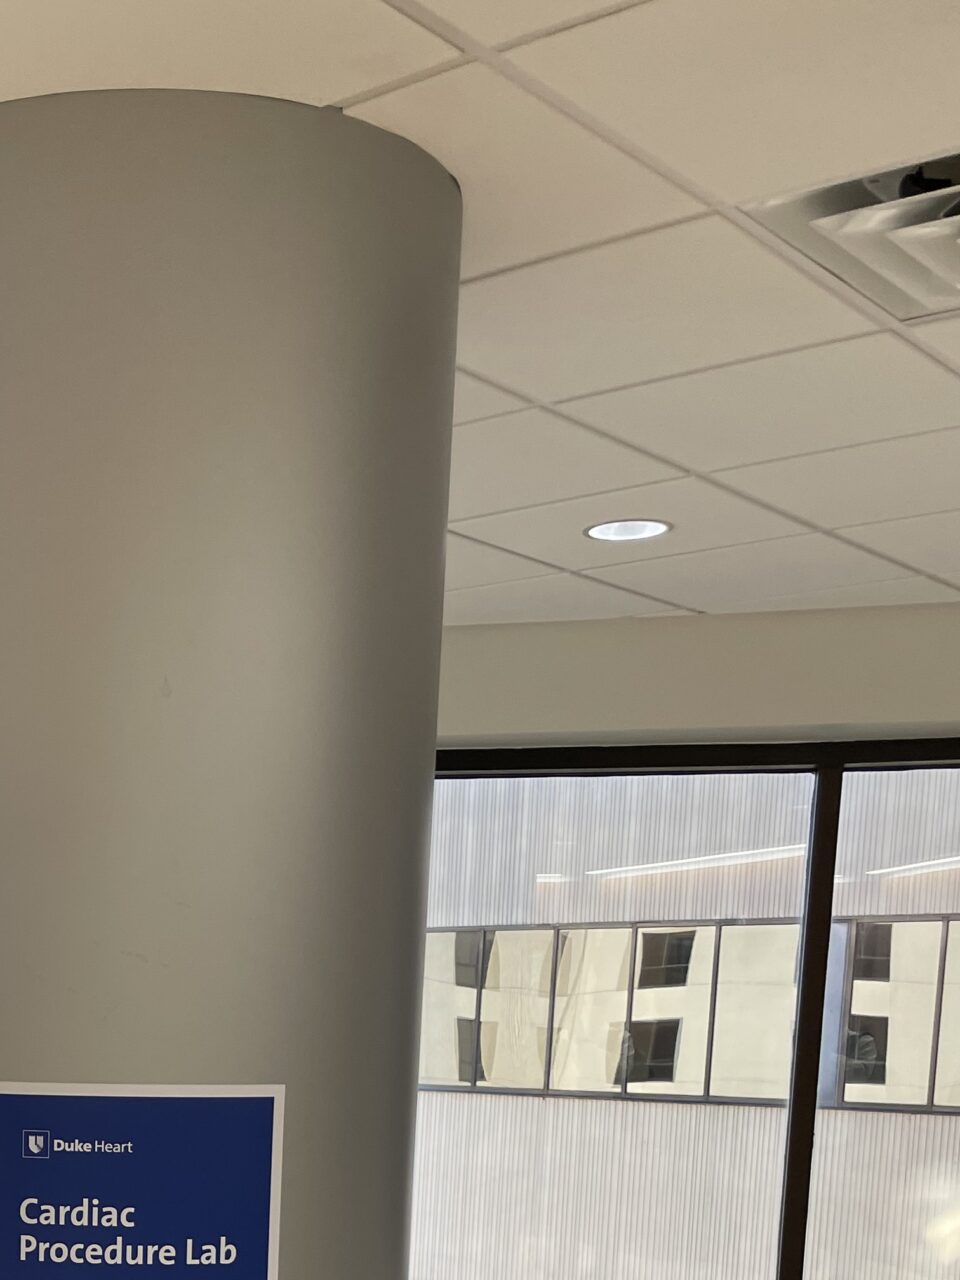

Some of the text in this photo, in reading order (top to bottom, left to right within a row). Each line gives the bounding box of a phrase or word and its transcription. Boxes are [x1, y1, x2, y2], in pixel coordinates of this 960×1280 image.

[53, 1139, 133, 1153] Duke Heart
[19, 1197, 135, 1228] Cardiac
[20, 1234, 237, 1266] Procedure Lab
